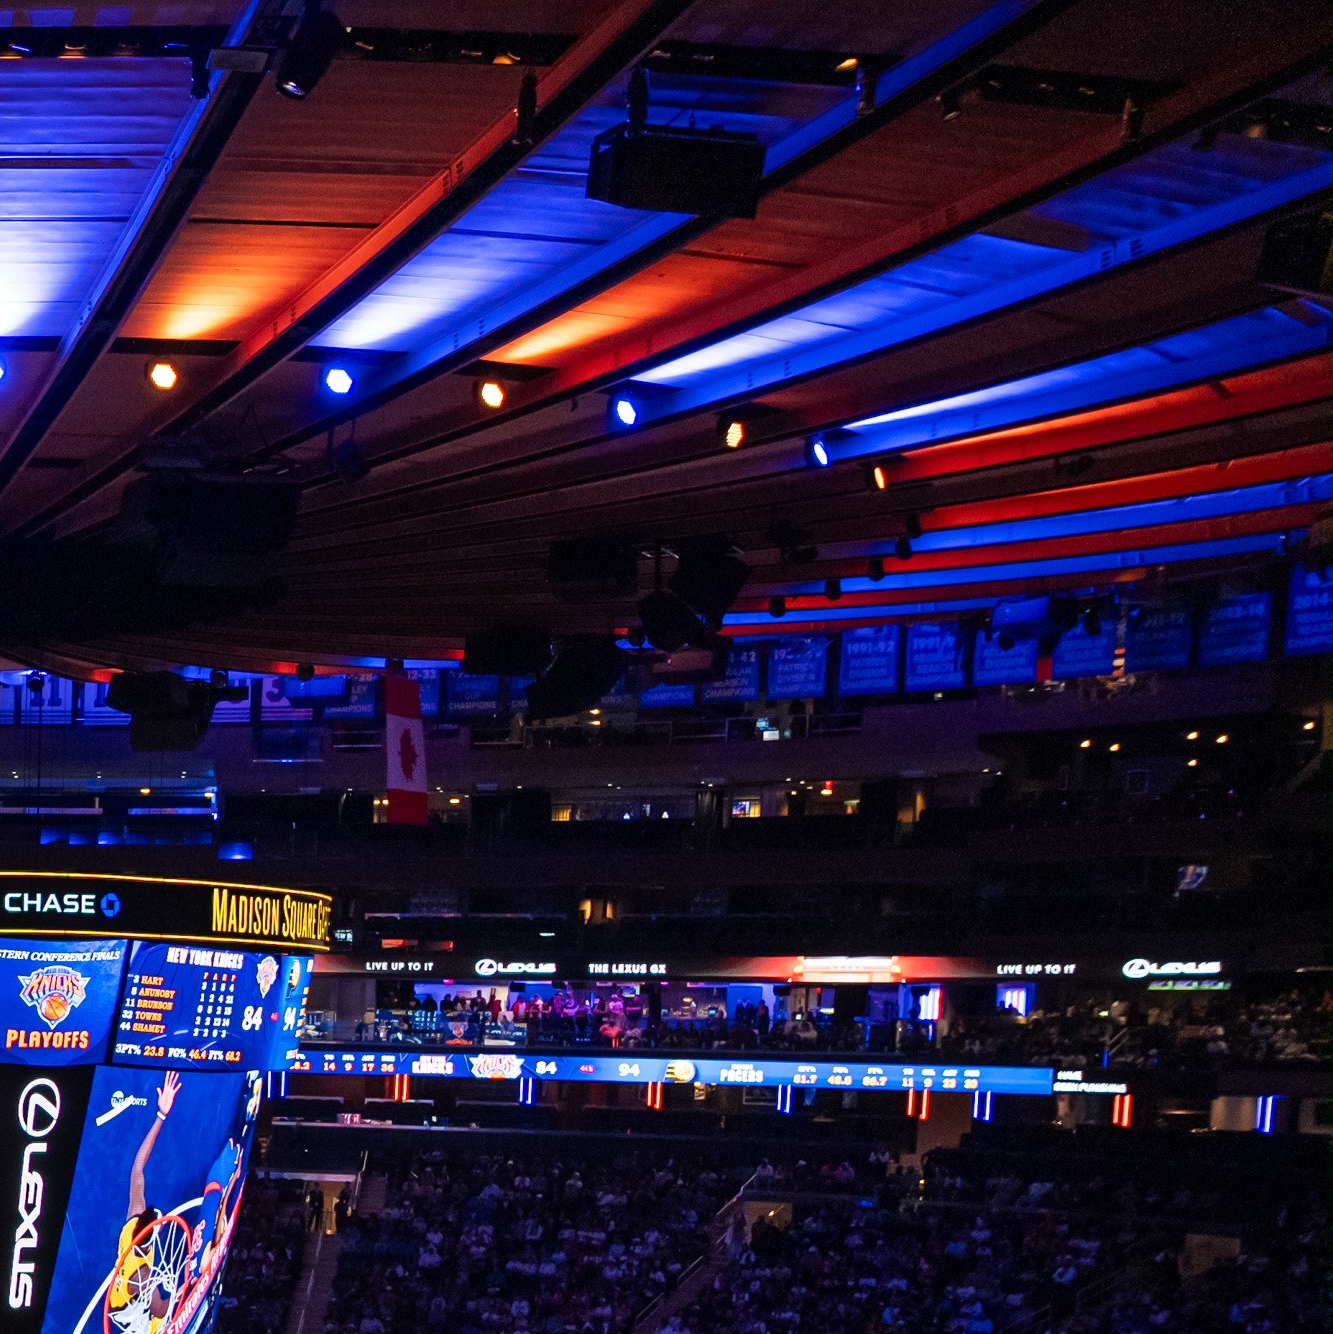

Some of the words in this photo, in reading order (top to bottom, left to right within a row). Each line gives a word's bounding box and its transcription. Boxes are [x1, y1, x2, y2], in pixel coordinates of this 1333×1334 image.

[5, 893, 96, 914] CHASE
[212, 888, 280, 935] MADISON
[282, 895, 316, 940] SQUARE
[31, 951, 91, 962] CONFERENCE
[91, 951, 121, 960] FINALS
[167, 947, 189, 964] NEW
[189, 949, 213, 966] YORK
[213, 951, 244, 969] KNICKS
[366, 962, 389, 971] LIVE
[391, 962, 404, 971] UP
[407, 962, 421, 971] TO
[423, 962, 433, 971] IT
[589, 964, 609, 973] THE
[611, 964, 647, 973] LEXUS
[649, 964, 666, 973] GX
[997, 964, 1022, 975] LIVE
[1025, 965, 1042, 974] UP
[1045, 964, 1061, 974] TO
[1064, 964, 1076, 974] IT
[25, 974, 84, 996] KNICKS
[141, 975, 164, 985] HART
[139, 988, 175, 999] ANUNOBY
[125, 998, 135, 1007] 11
[137, 999, 174, 1011] BRUNSON
[122, 1010, 133, 1019] 32
[135, 1011, 163, 1021] TOWNS
[241, 1006, 263, 1031] 84
[120, 1022, 131, 1030] 44
[133, 1023, 165, 1033] SHAMET
[5, 1029, 89, 1050] PLAYOFFS
[115, 1043, 141, 1055] 3PT%
[144, 1045, 165, 1057] 23.8
[189, 1049, 207, 1059] 46.4
[324, 1062, 335, 1071] 14
[345, 1063, 352, 1071] 9
[362, 1063, 374, 1072] 17
[536, 1061, 557, 1075] 84
[618, 1063, 640, 1077] 94
[793, 1074, 818, 1085] 51.7
[902, 1077, 914, 1088] 11
[9, 1142, 47, 1309] LEXUS
